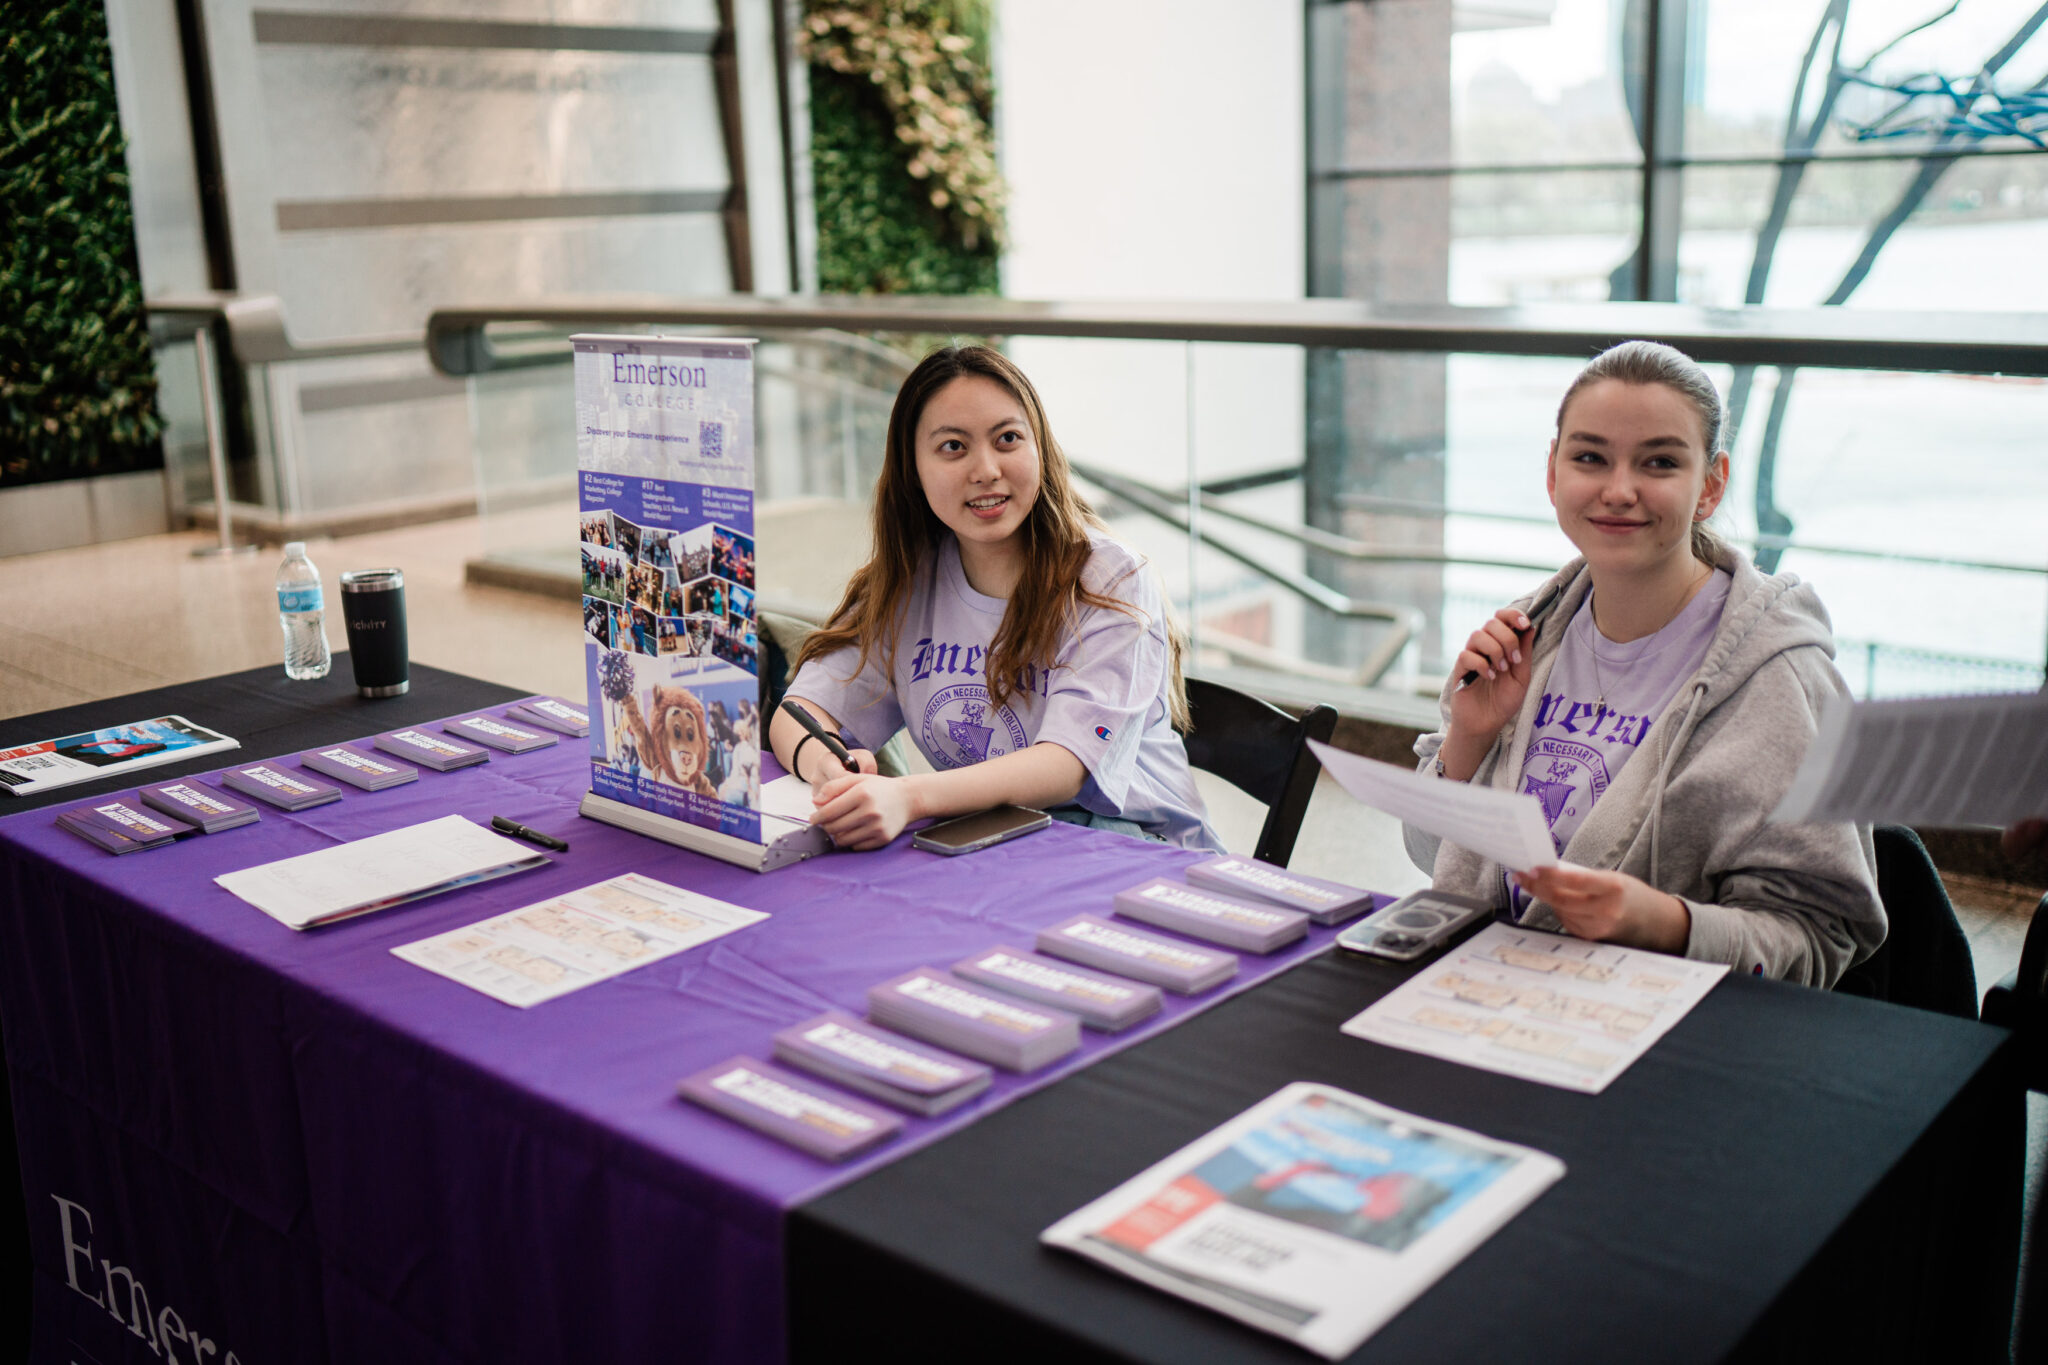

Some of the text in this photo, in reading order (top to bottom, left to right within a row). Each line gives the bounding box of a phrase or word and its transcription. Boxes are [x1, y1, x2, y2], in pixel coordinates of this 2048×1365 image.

[612, 352, 707, 388] Emerson
[624, 393, 696, 411] COLLEGE
[586, 426, 690, 443] Discover your Emerson experience
[584, 474, 592, 483] #2
[642, 480, 653, 490] #17
[702, 488, 711, 497] #3
[925, 690, 952, 731] EXPRESSION
[1000, 706, 1025, 749] EVOLUTION
[990, 747, 1005, 757] 80
[1543, 741, 1595, 763] NECESSARY
[594, 765, 602, 774] #9
[637, 778, 645, 787] #5
[158, 784, 236, 813] EXTRAORDINARY
[689, 793, 697, 802] #2
[94, 802, 173, 832] EXTRAORDINARY
